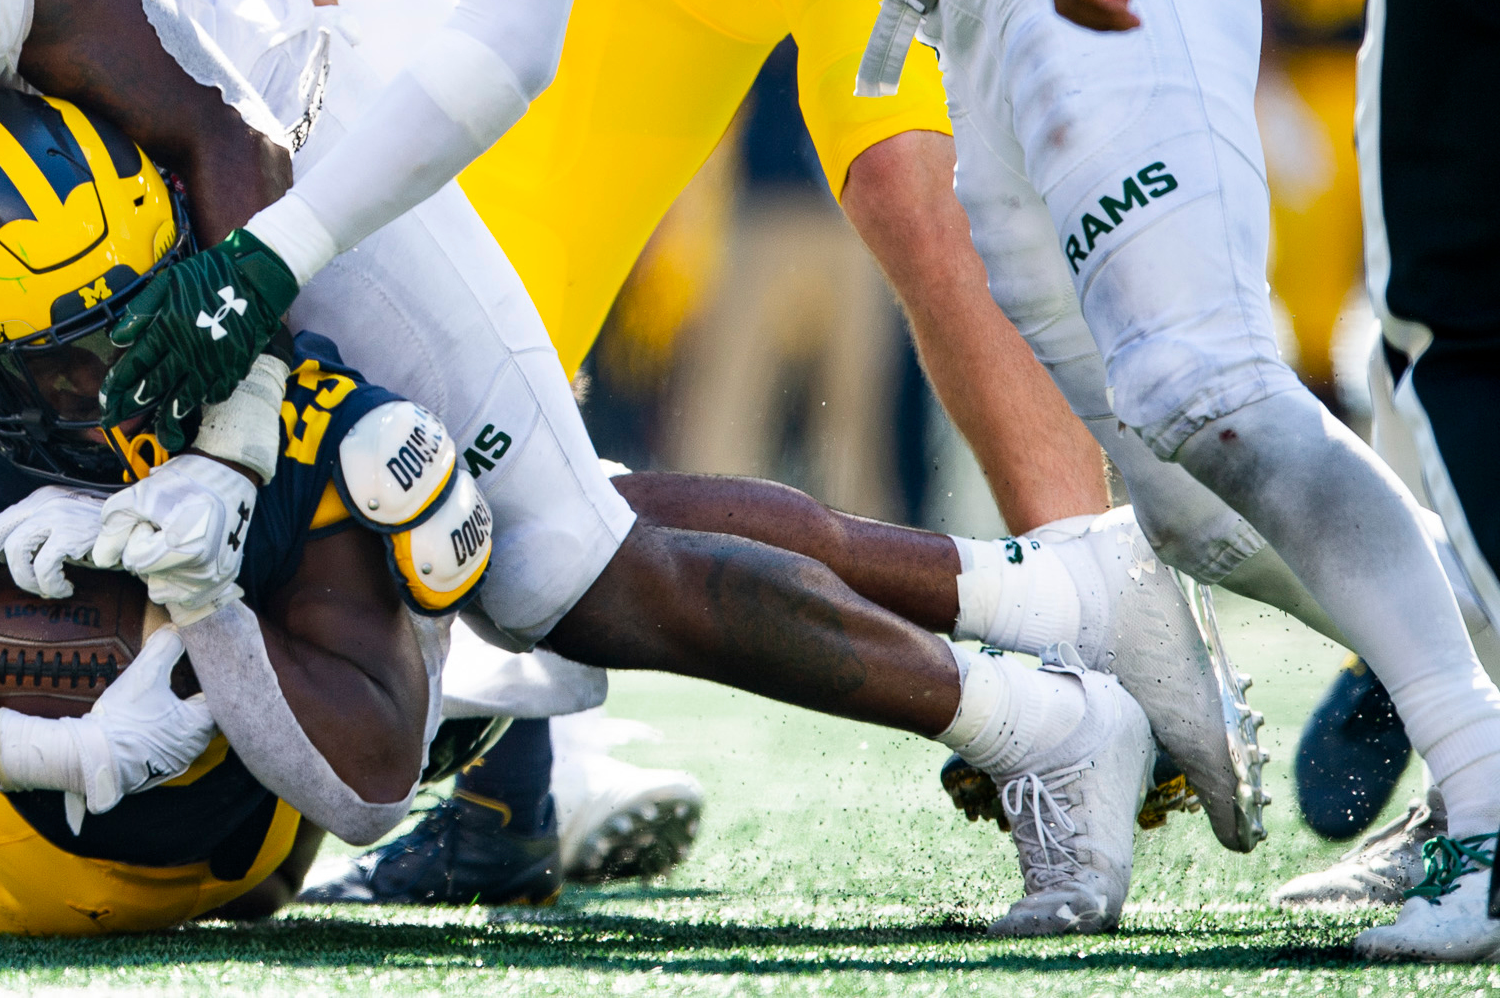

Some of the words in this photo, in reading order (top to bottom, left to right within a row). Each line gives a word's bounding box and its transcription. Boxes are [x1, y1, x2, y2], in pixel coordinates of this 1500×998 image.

[1065, 161, 1178, 276] RAMS
[78, 276, 112, 309] M
[280, 358, 357, 465] 23
